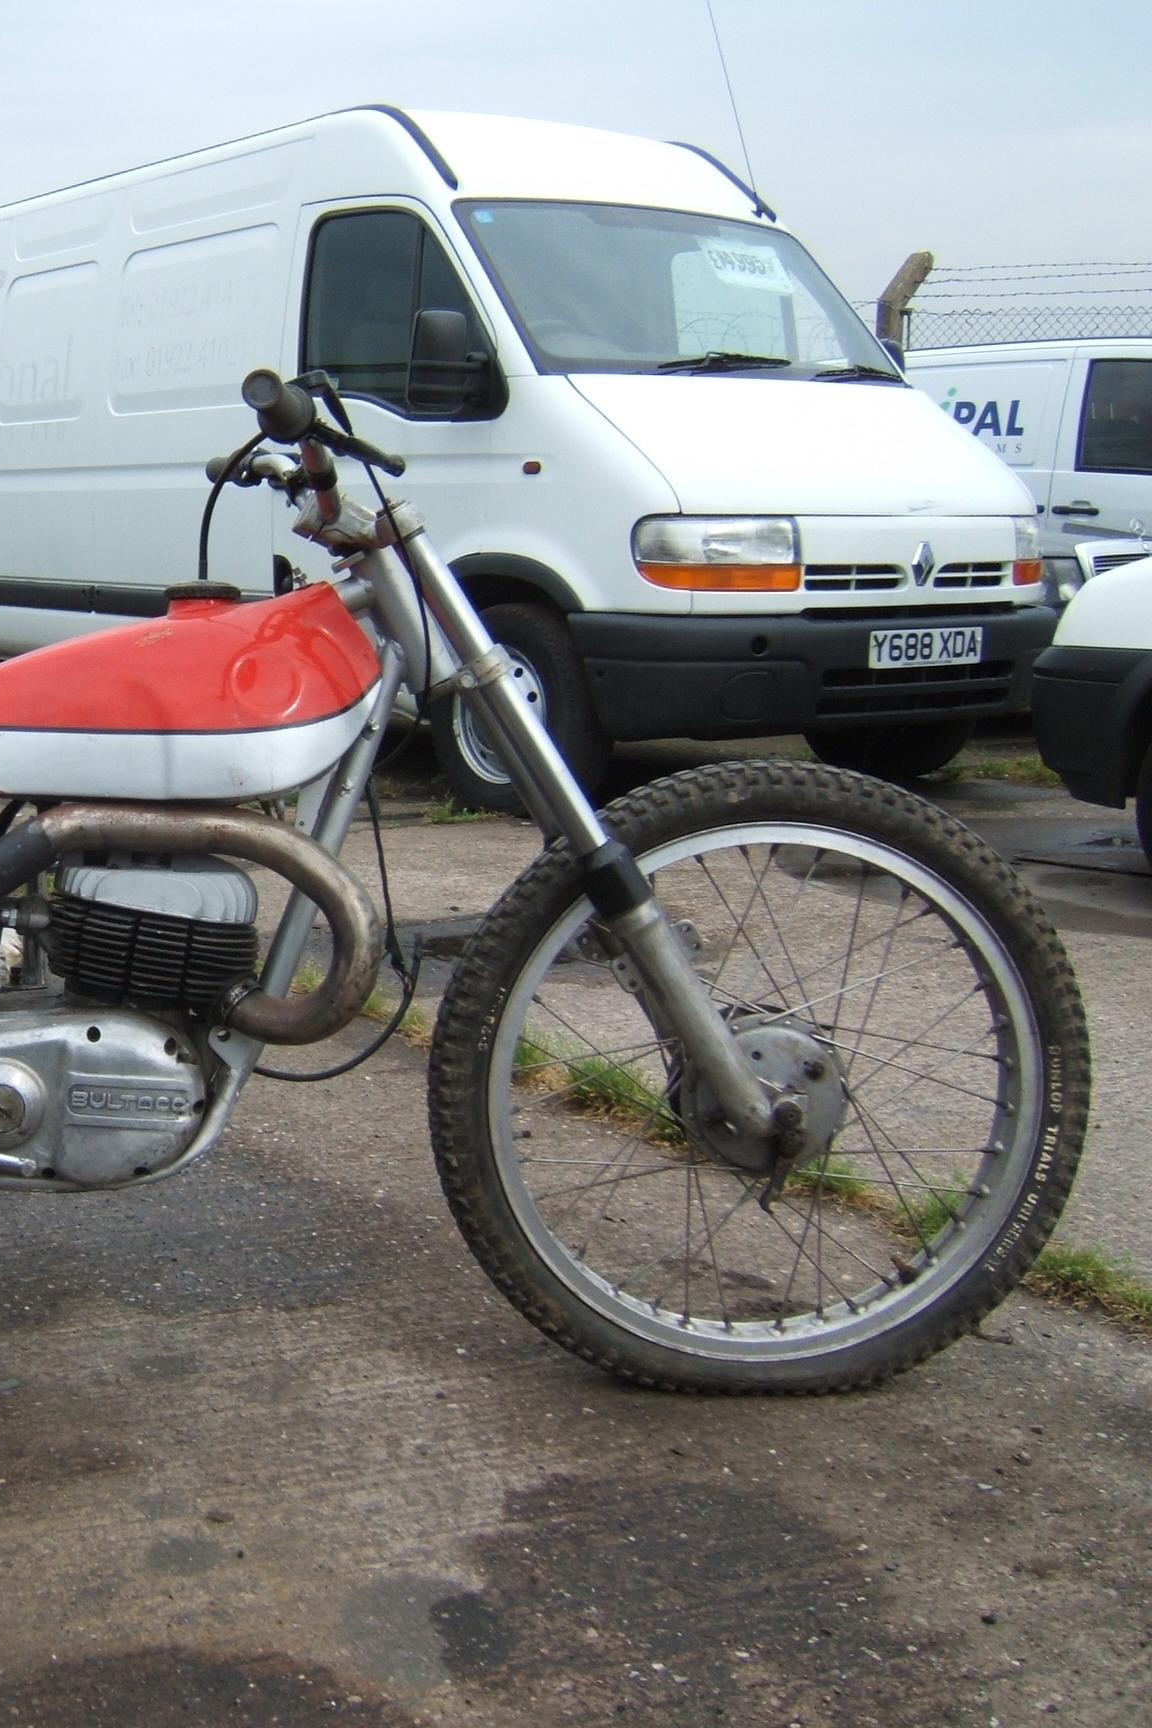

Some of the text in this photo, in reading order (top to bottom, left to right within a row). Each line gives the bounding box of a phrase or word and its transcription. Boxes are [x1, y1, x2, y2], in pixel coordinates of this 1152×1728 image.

[873, 630, 978, 663] Y688 XDA
[71, 1090, 188, 1113] BULTACO
[1048, 1045, 1063, 1113] DUNLOP
[1035, 1125, 1059, 1182] TRIALS
